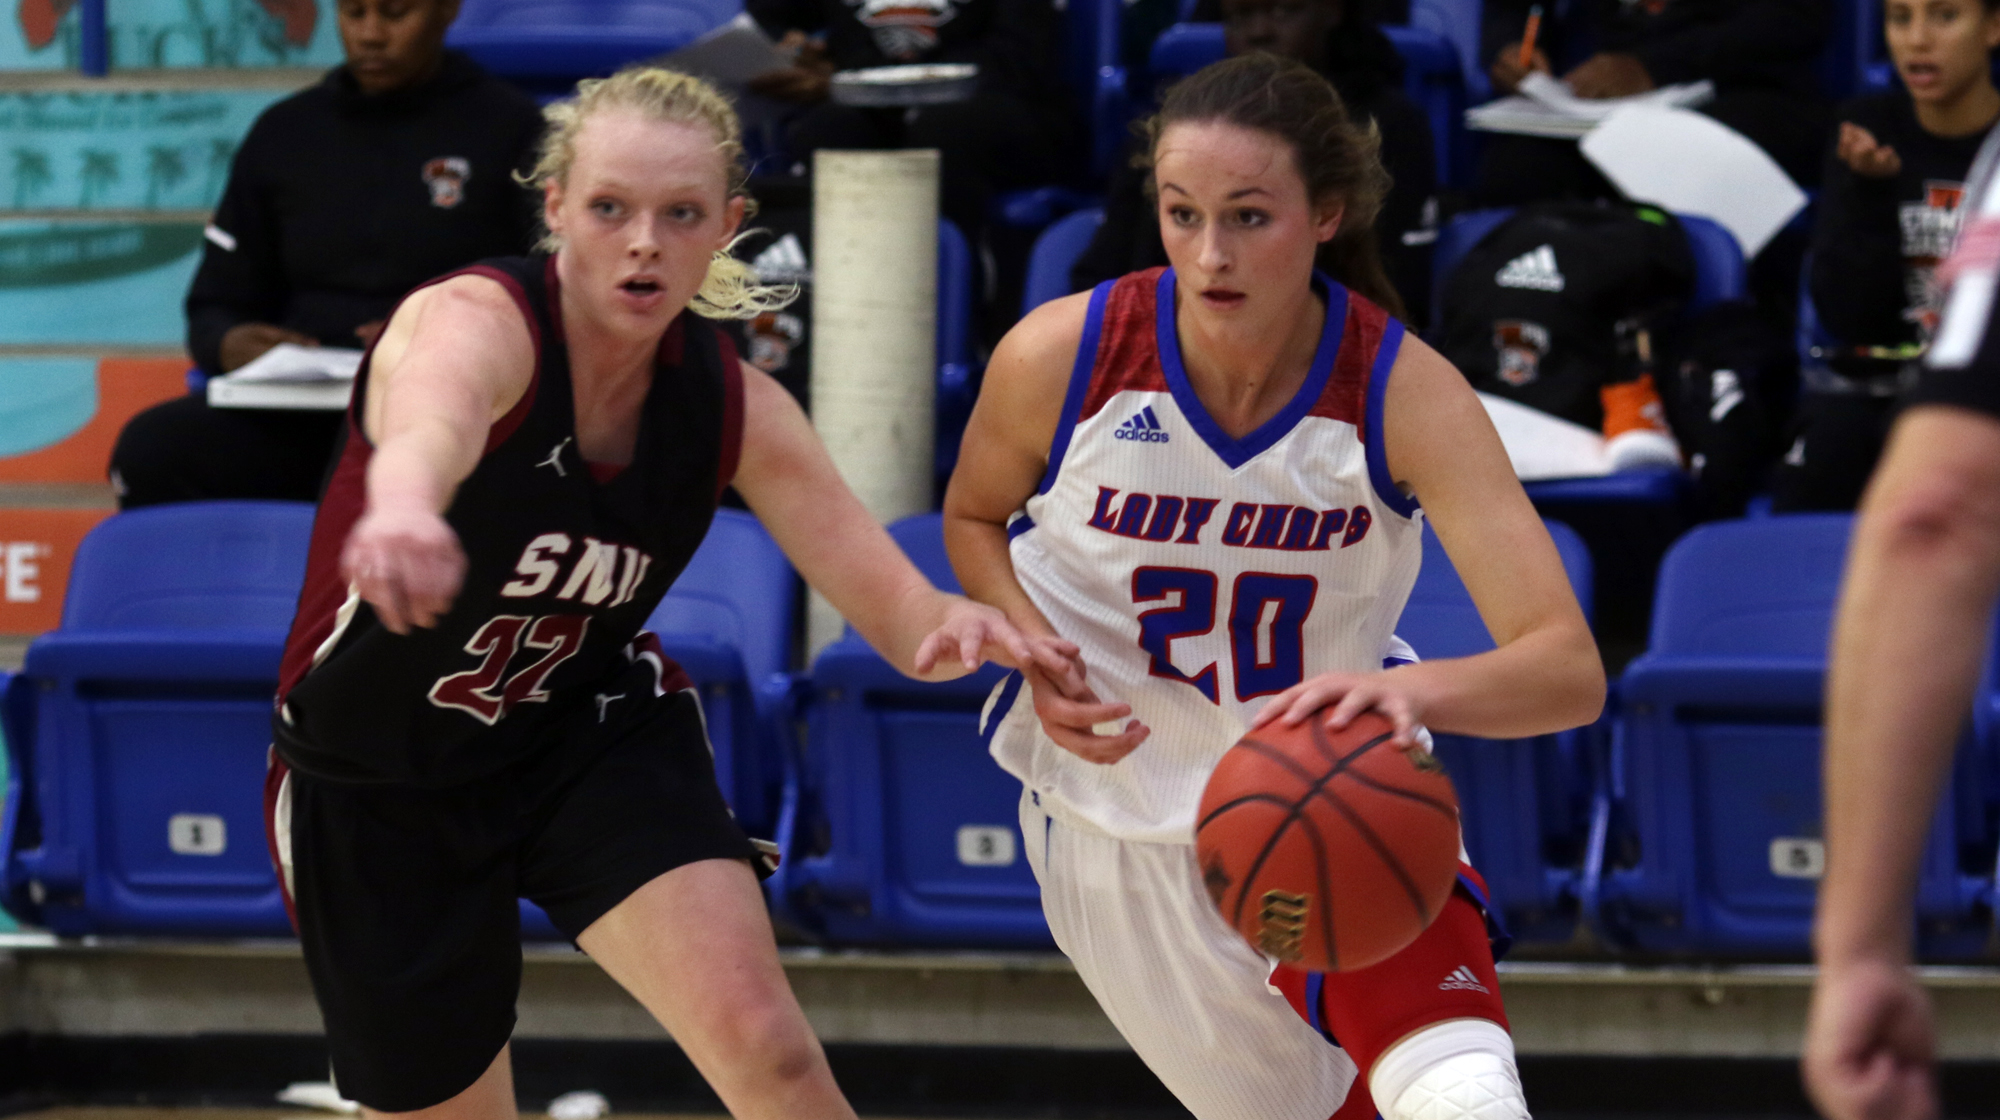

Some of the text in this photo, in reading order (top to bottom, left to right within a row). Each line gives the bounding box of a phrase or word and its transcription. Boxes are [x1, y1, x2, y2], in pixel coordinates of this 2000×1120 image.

[1114, 427, 1170, 443] adidas
[1087, 486, 1372, 551] LADY CHAPS
[427, 614, 593, 727] 22
[1131, 565, 1319, 706] 20
